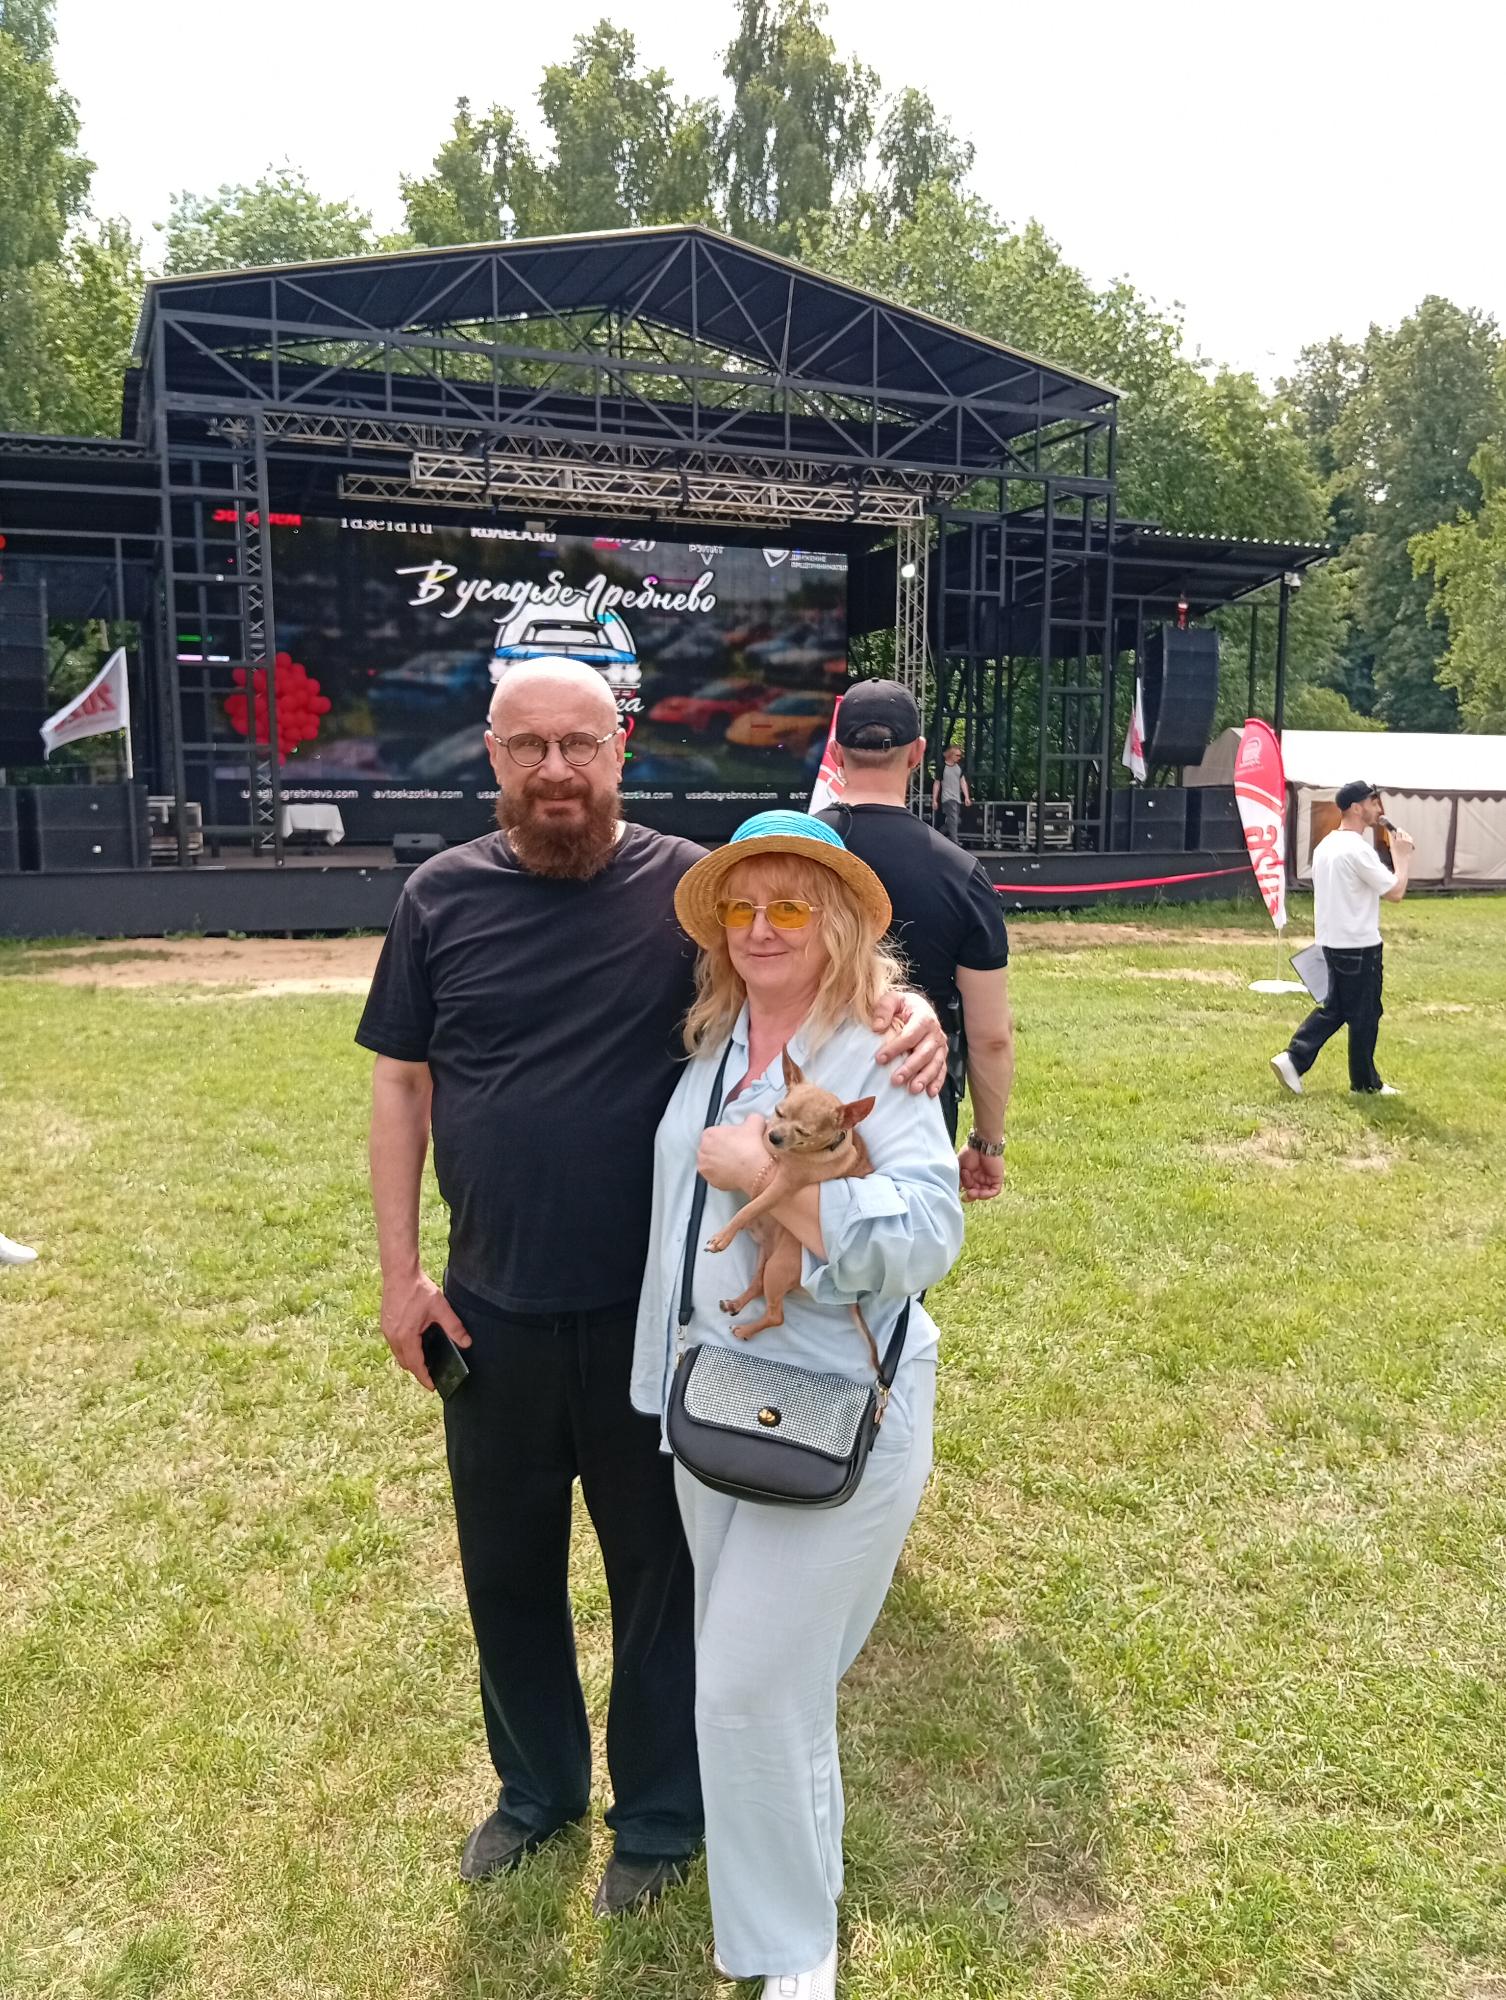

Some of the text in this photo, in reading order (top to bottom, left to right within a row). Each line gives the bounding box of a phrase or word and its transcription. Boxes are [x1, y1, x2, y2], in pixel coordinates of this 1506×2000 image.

[395, 560, 717, 625] В усадьбе Гребнево
